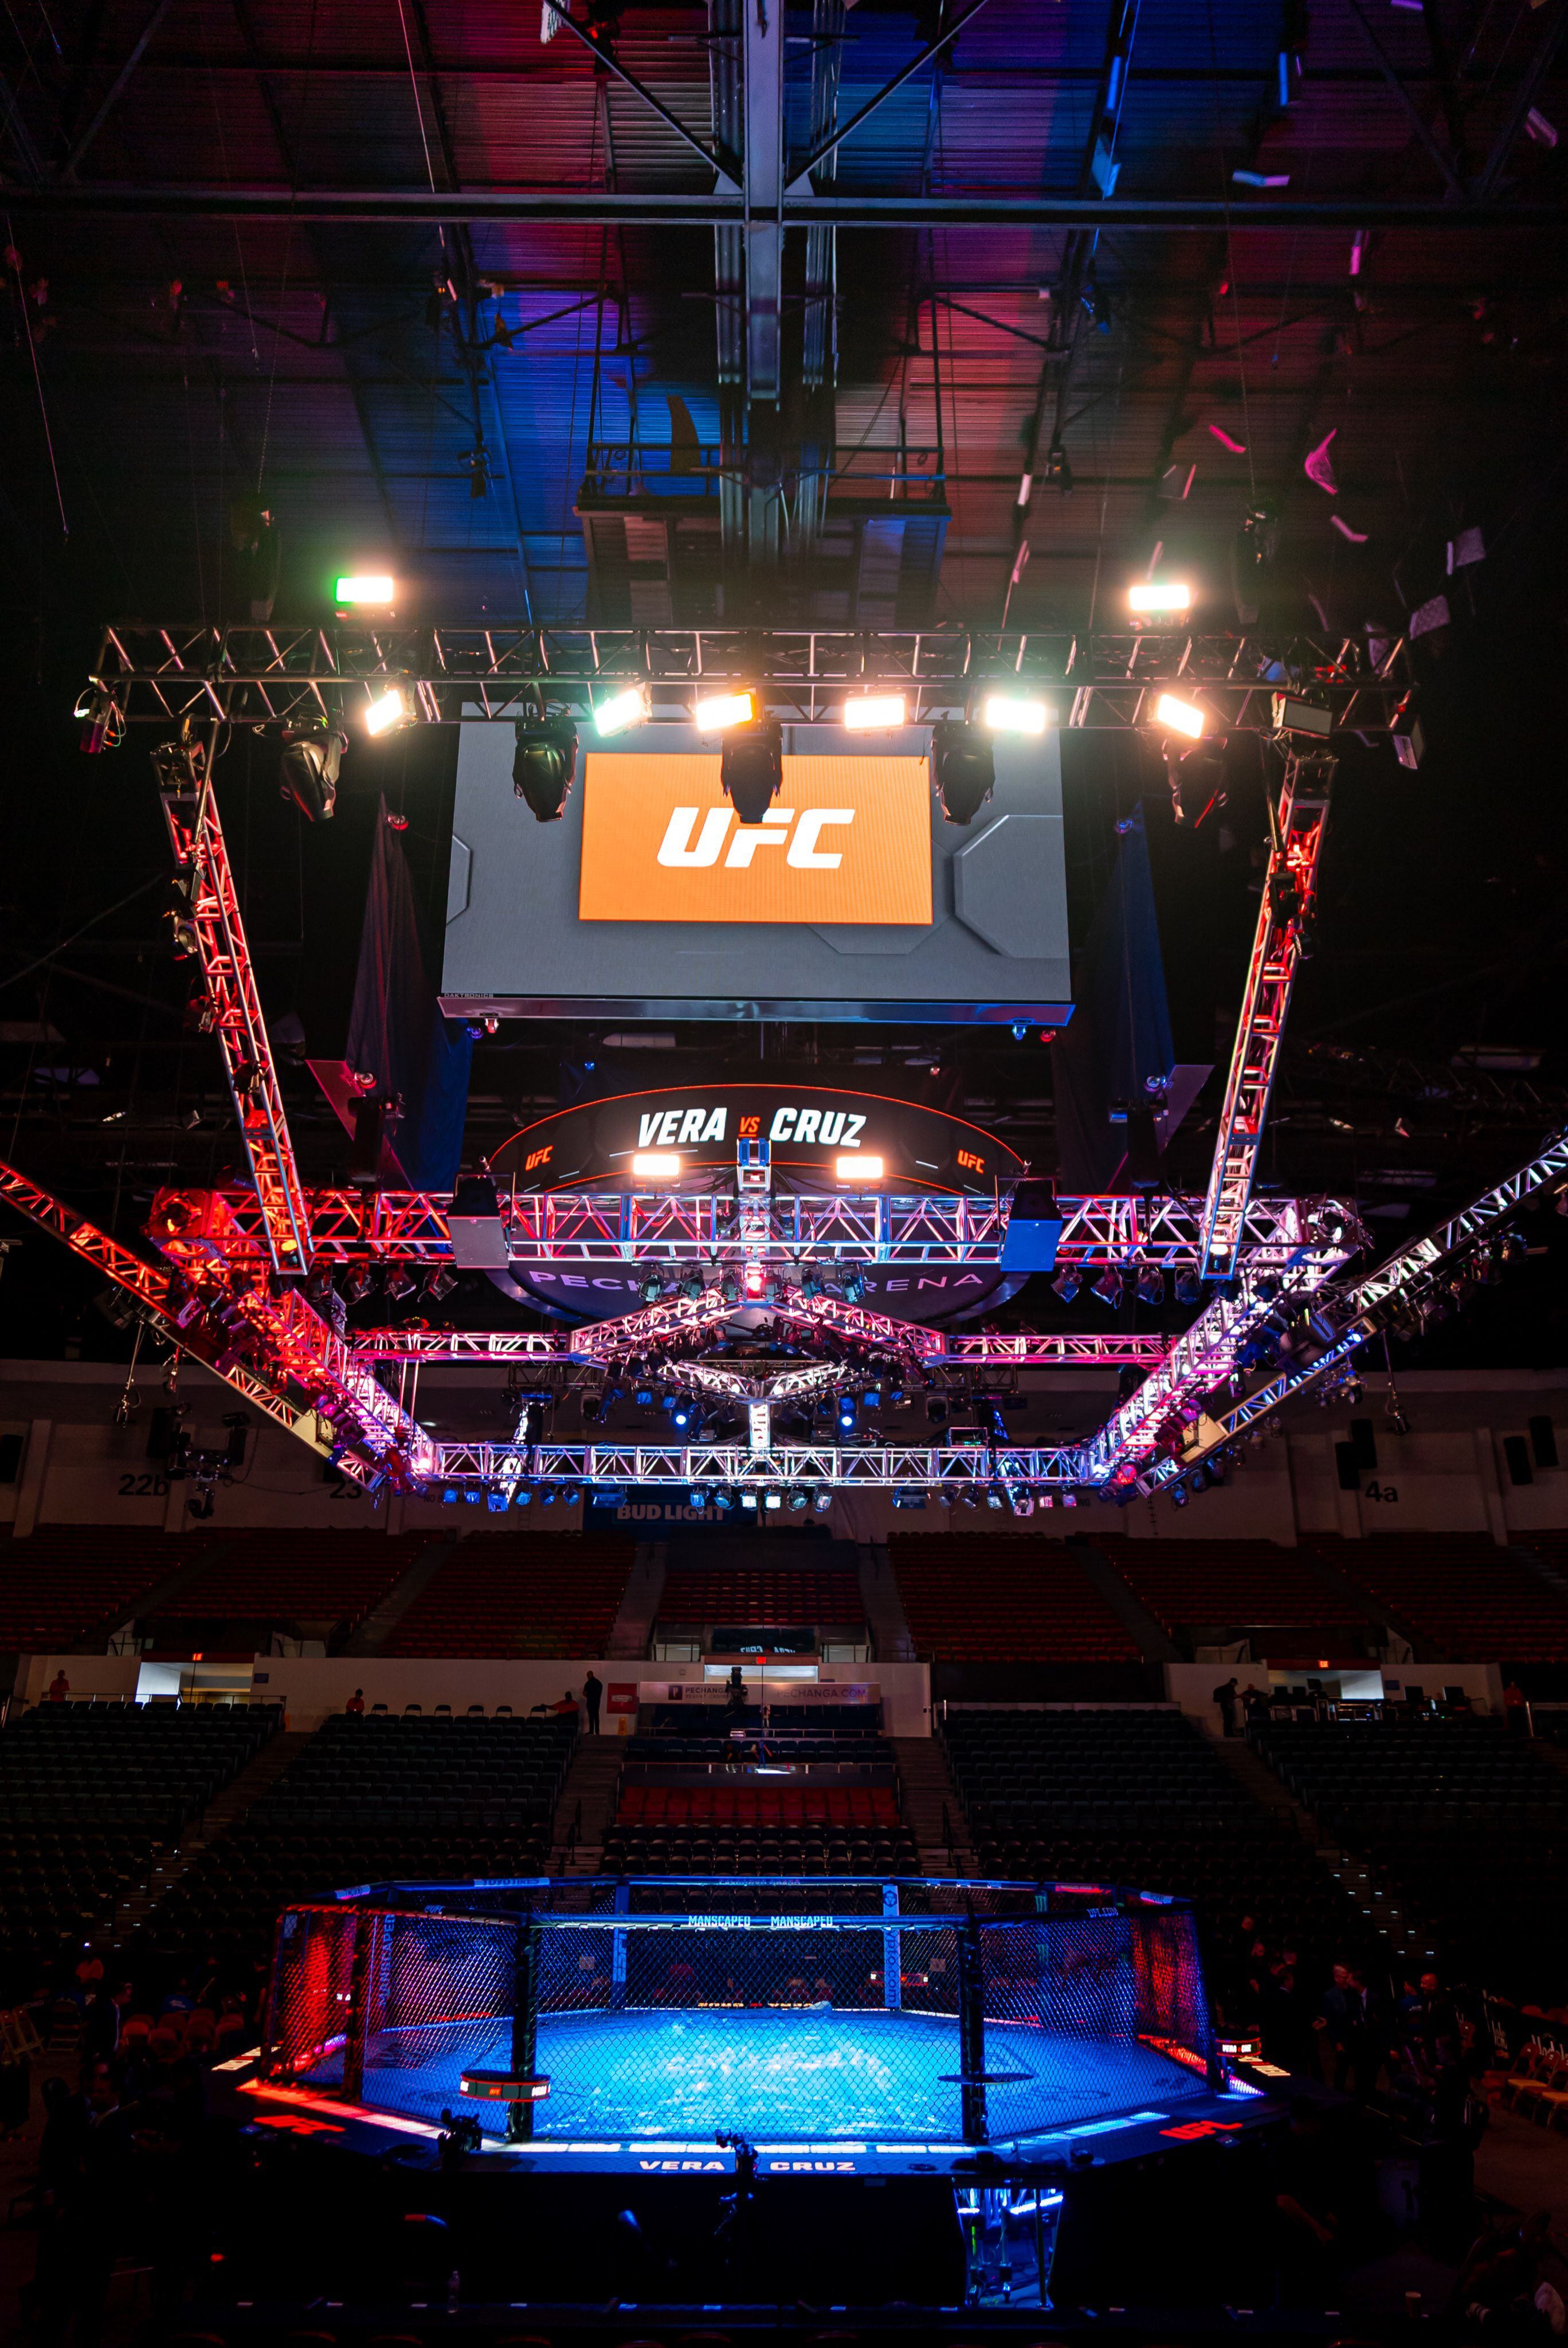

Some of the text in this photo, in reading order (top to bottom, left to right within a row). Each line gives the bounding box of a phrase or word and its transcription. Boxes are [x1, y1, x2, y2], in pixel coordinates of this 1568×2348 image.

[657, 807, 855, 868] UFC
[638, 1108, 867, 1147] VERA VS CRUZ
[525, 1145, 554, 1171] UFC
[957, 1149, 985, 1174] UFC
[118, 1474, 168, 1496] 22b
[330, 1481, 362, 1499] 23
[1366, 1482, 1398, 1502] 4a
[617, 1504, 723, 1520] BUD LIGHT
[777, 1689, 866, 1697] PECHANGA.COM
[688, 1915, 833, 1927] MANSCAPED MANSCAPED
[378, 1914, 396, 2006] MANSCAPED
[885, 1927, 897, 2003] ypto.com
[639, 2161, 856, 2171] VERA CRUZ
